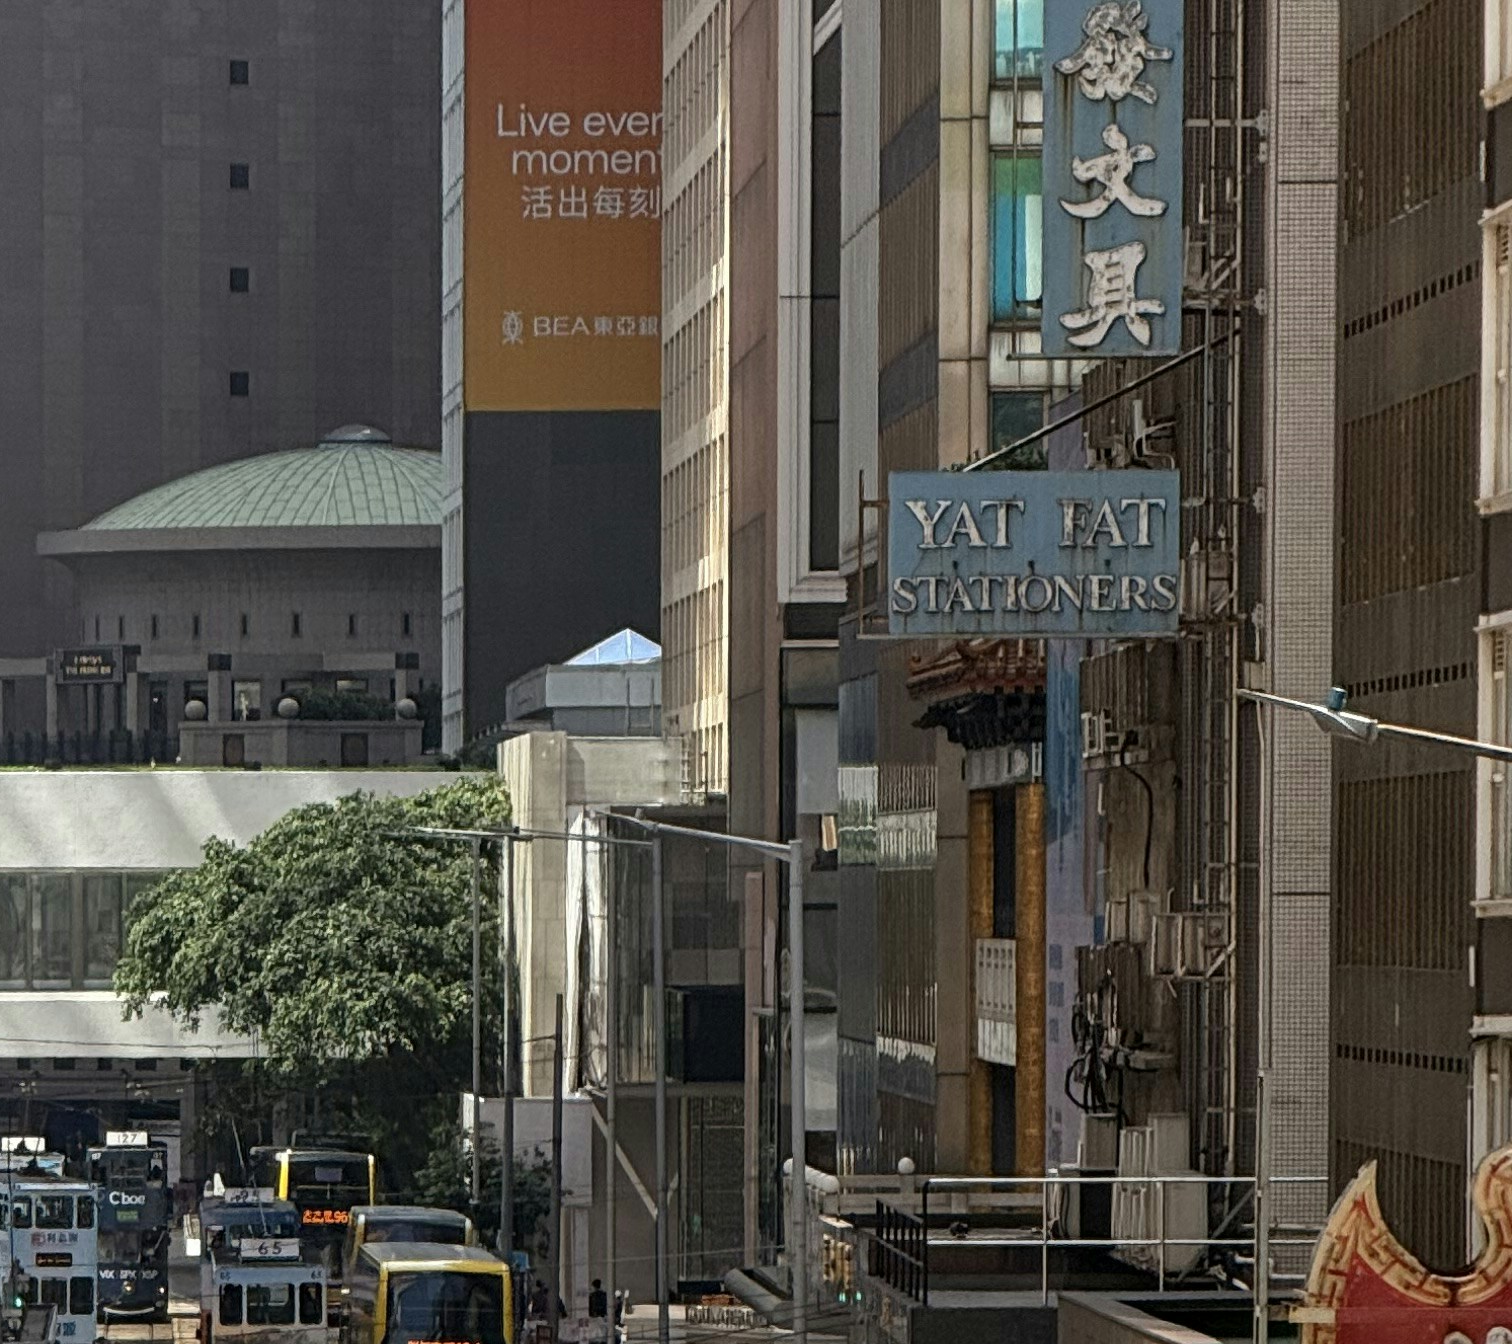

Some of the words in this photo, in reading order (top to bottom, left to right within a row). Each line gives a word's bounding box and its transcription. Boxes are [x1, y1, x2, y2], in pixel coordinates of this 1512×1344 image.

[496, 103, 571, 137] Live
[583, 110, 664, 137] ever
[512, 146, 664, 175] momen
[1053, 0, 1174, 347] 發文具
[521, 185, 661, 220] 活出每刻
[534, 317, 589, 336] BEA
[593, 316, 658, 336] 東亞銀
[905, 500, 1024, 549] YAT
[1058, 498, 1167, 549] FAT
[891, 574, 1178, 614] STATIONERS
[257, 1241, 282, 1256] 65
